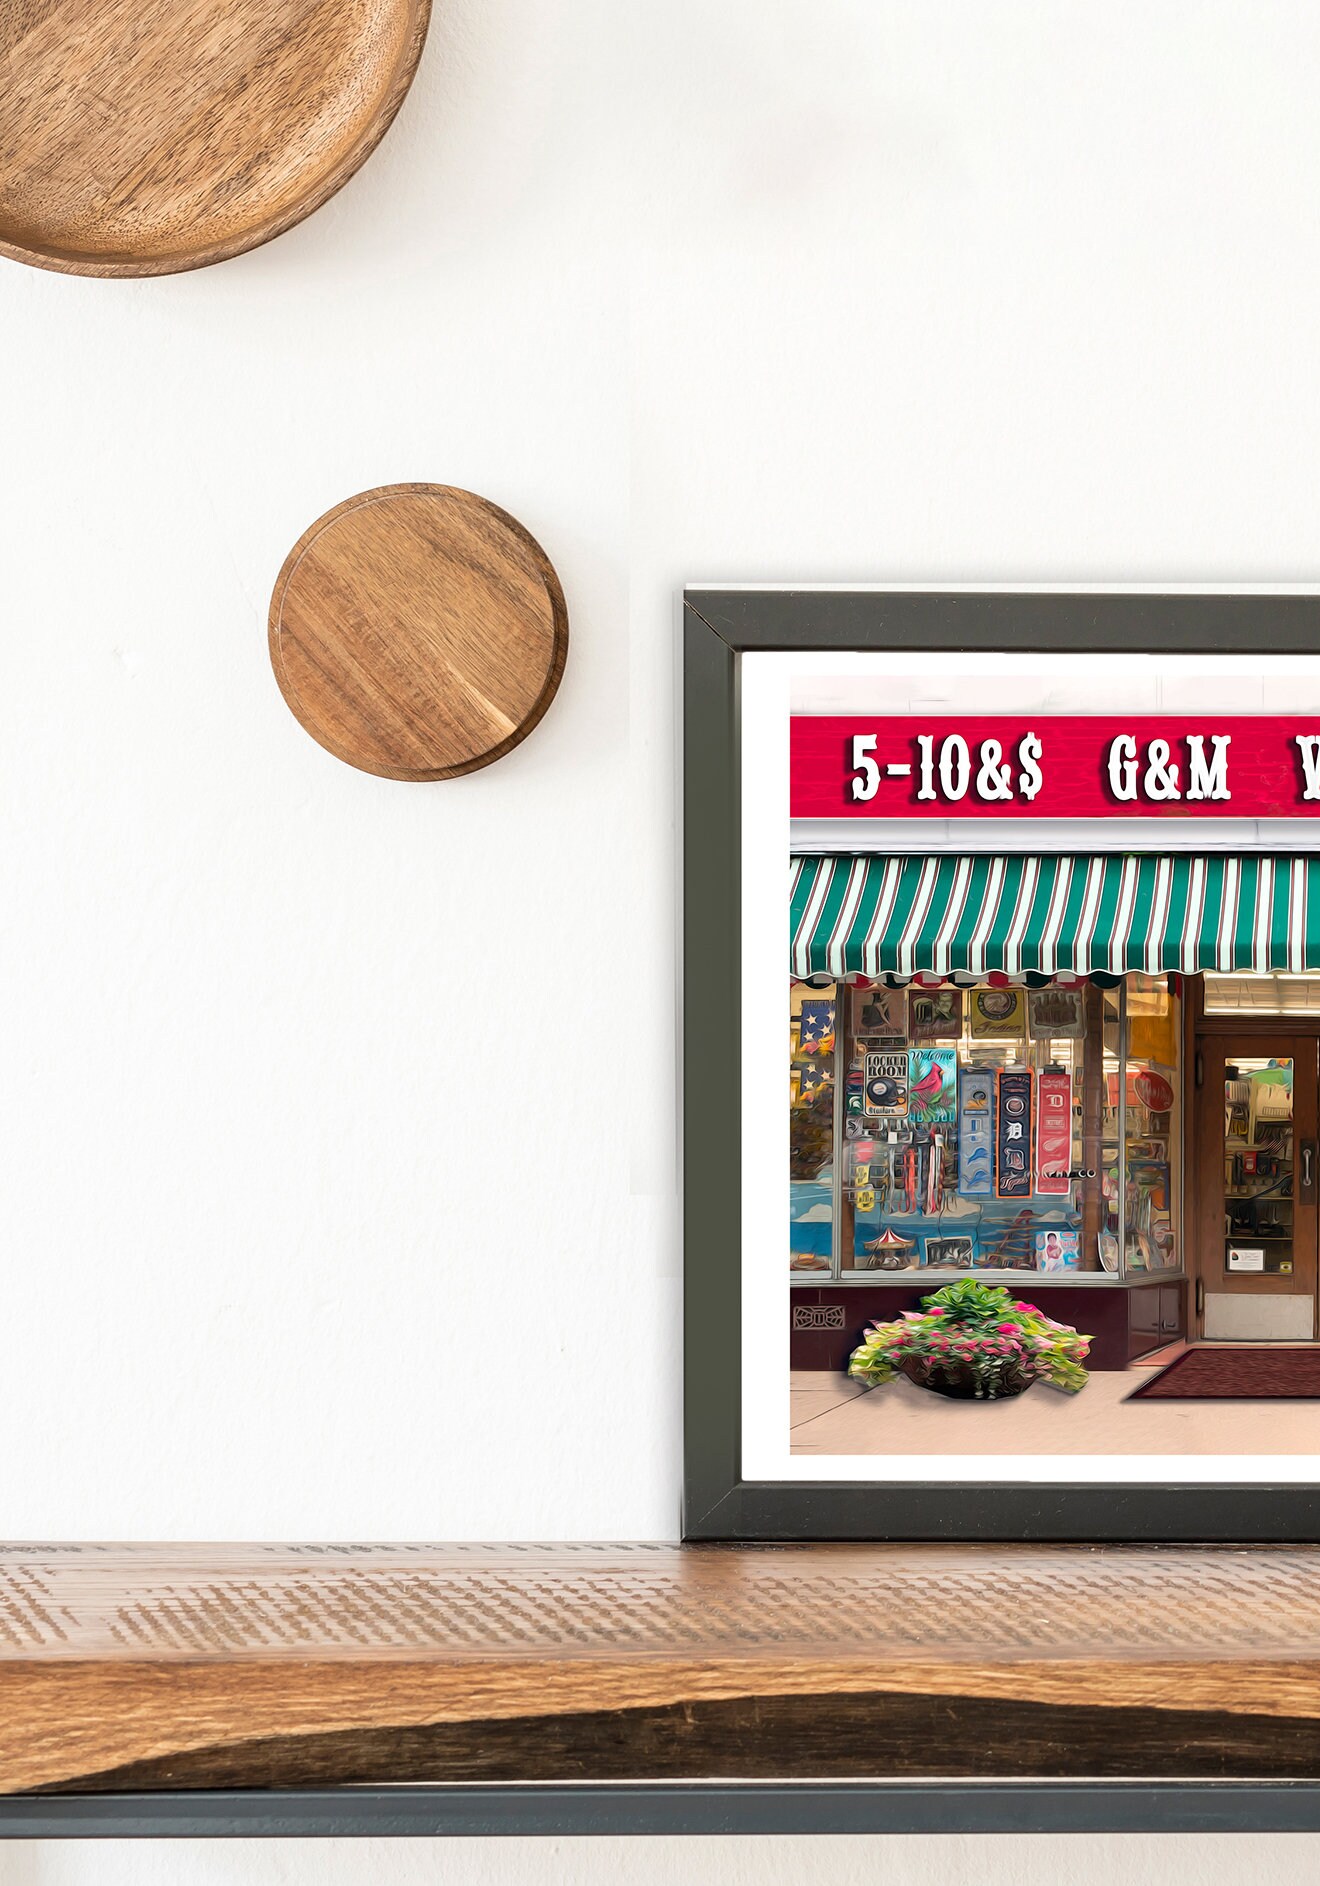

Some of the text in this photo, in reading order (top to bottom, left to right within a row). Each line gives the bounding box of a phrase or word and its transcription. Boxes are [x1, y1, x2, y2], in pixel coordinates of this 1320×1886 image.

[853, 732, 1044, 801] 5-10&$
[1107, 735, 1231, 801] G&M
[868, 1056, 906, 1066] LOCKER
[911, 1051, 954, 1061] Welcome
[868, 1066, 906, 1076] ROOM
